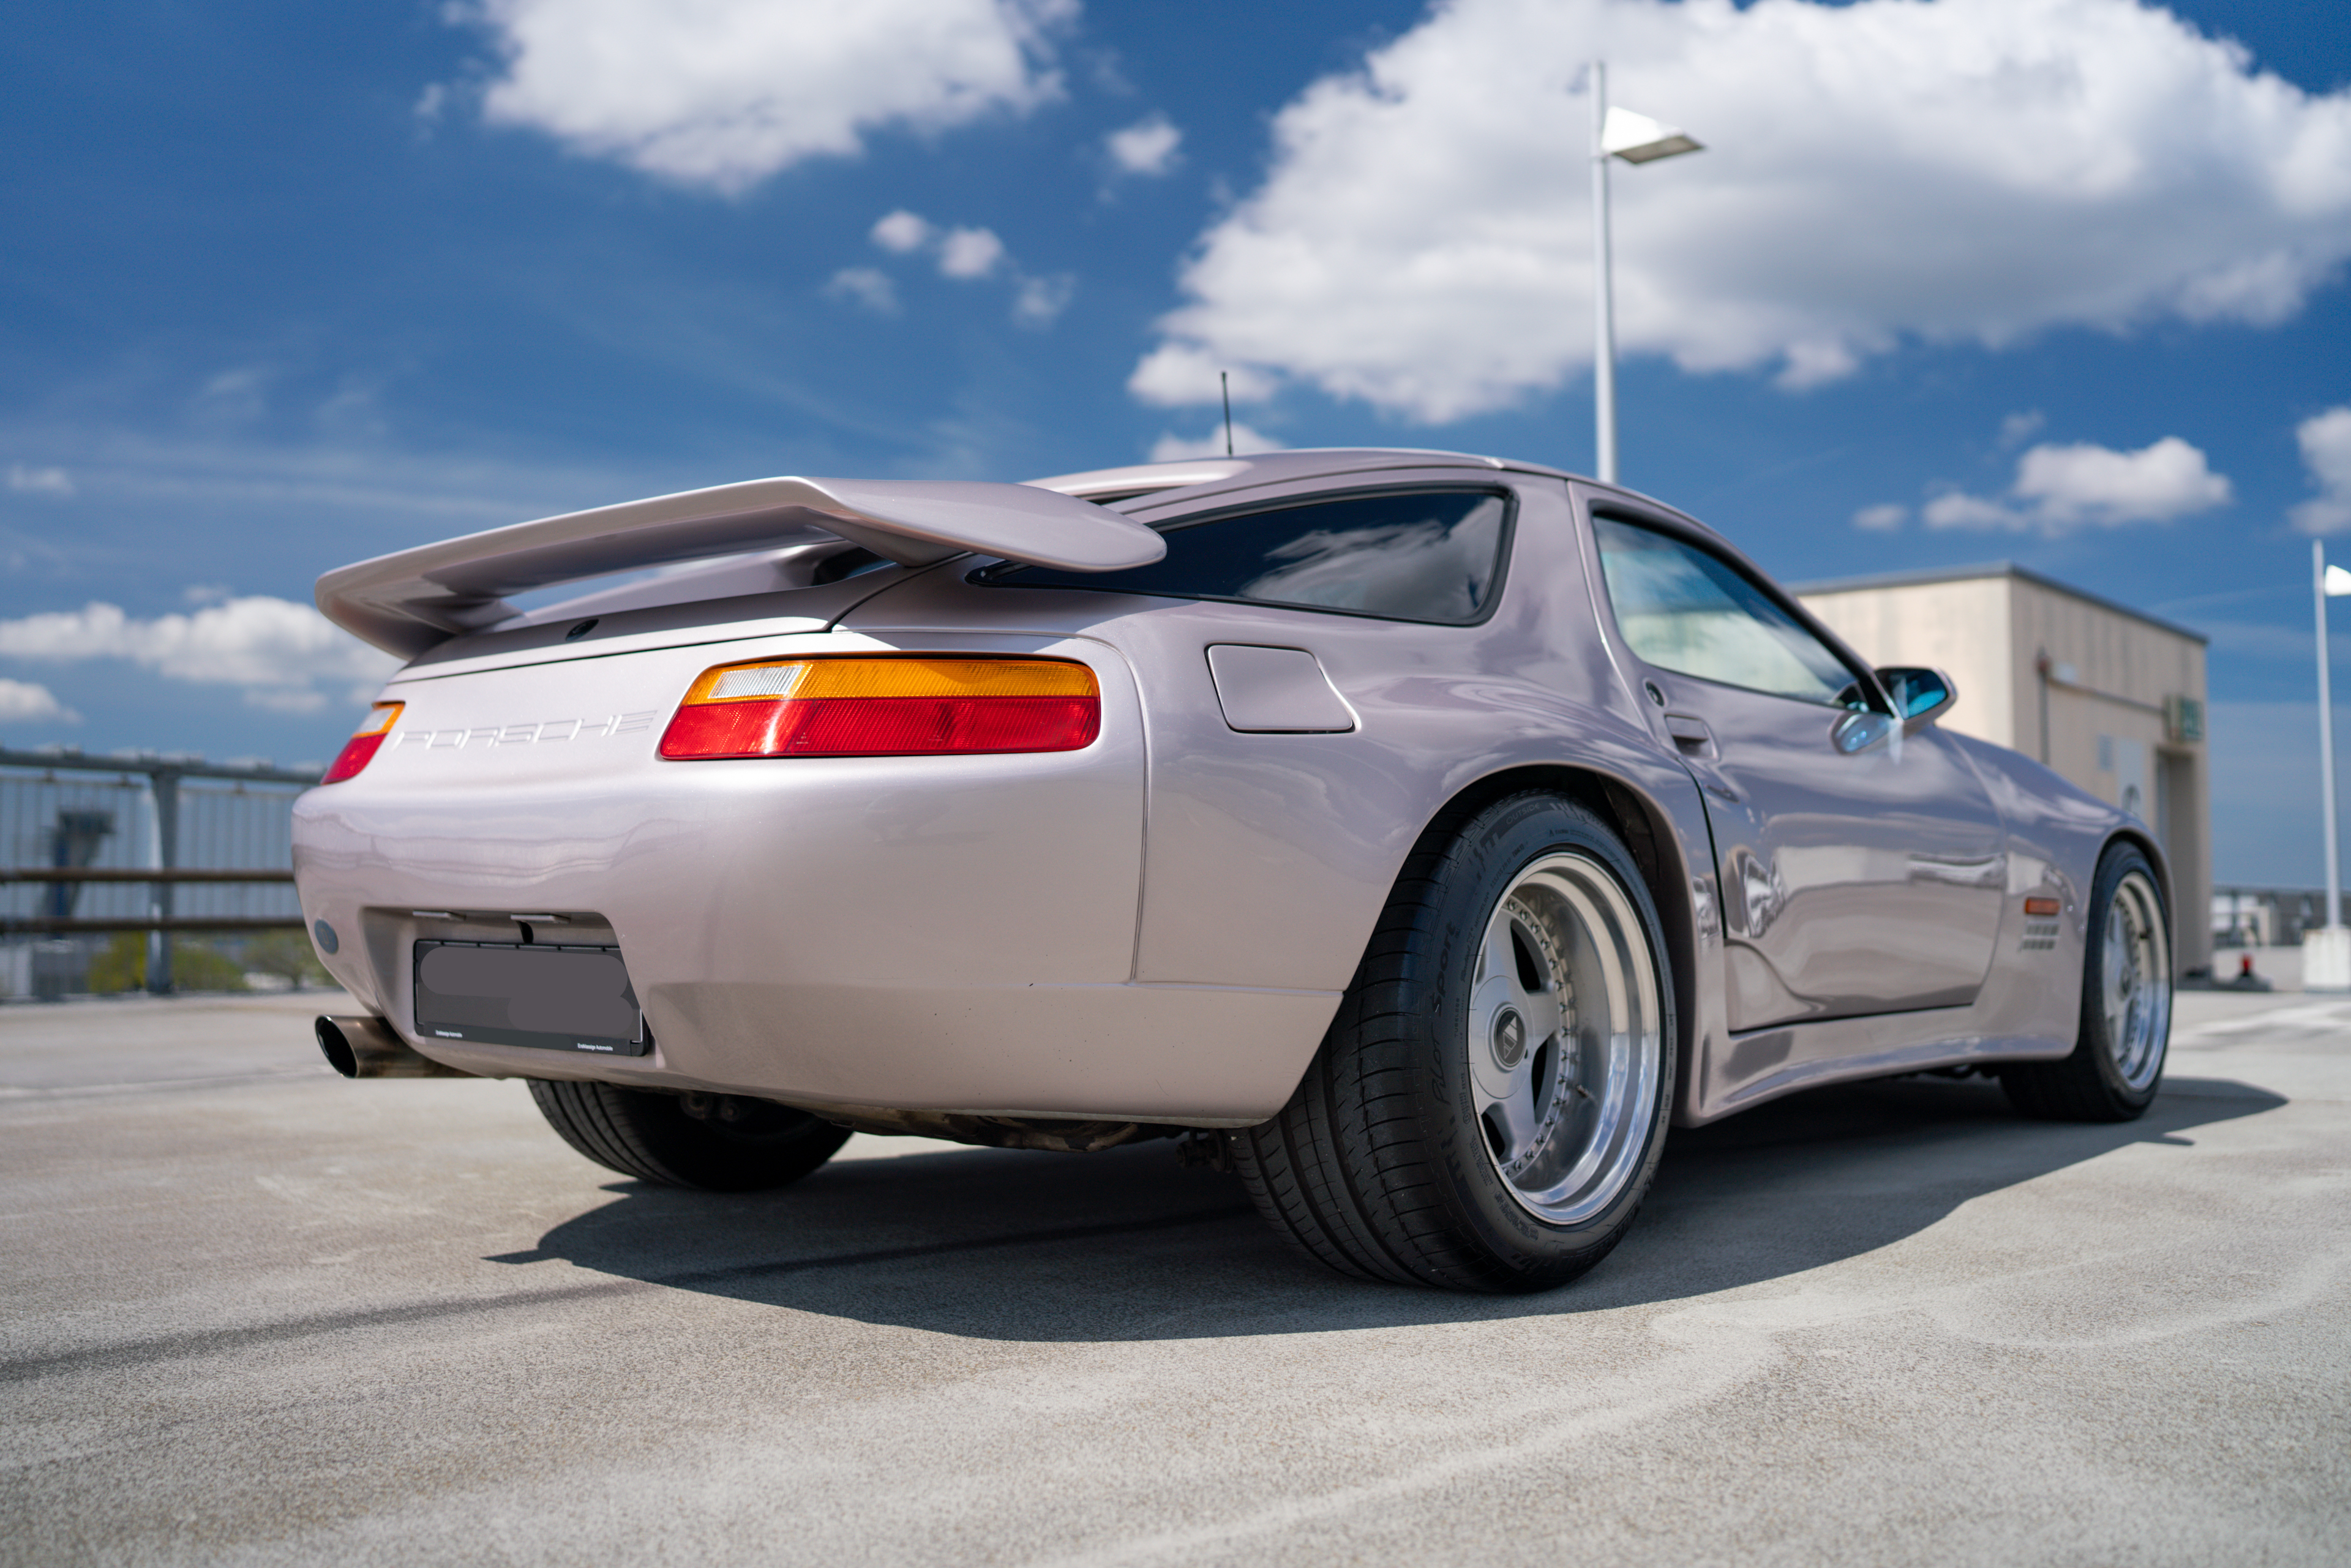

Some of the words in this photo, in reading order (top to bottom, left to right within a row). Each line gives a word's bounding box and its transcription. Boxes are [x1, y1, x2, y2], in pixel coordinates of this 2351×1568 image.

[391, 710, 658, 751] PORSCHE
[1506, 803, 1540, 825] OUTSIDE
[1475, 894, 1489, 927] MICHELIN
[1430, 920, 1455, 1017] Sport
